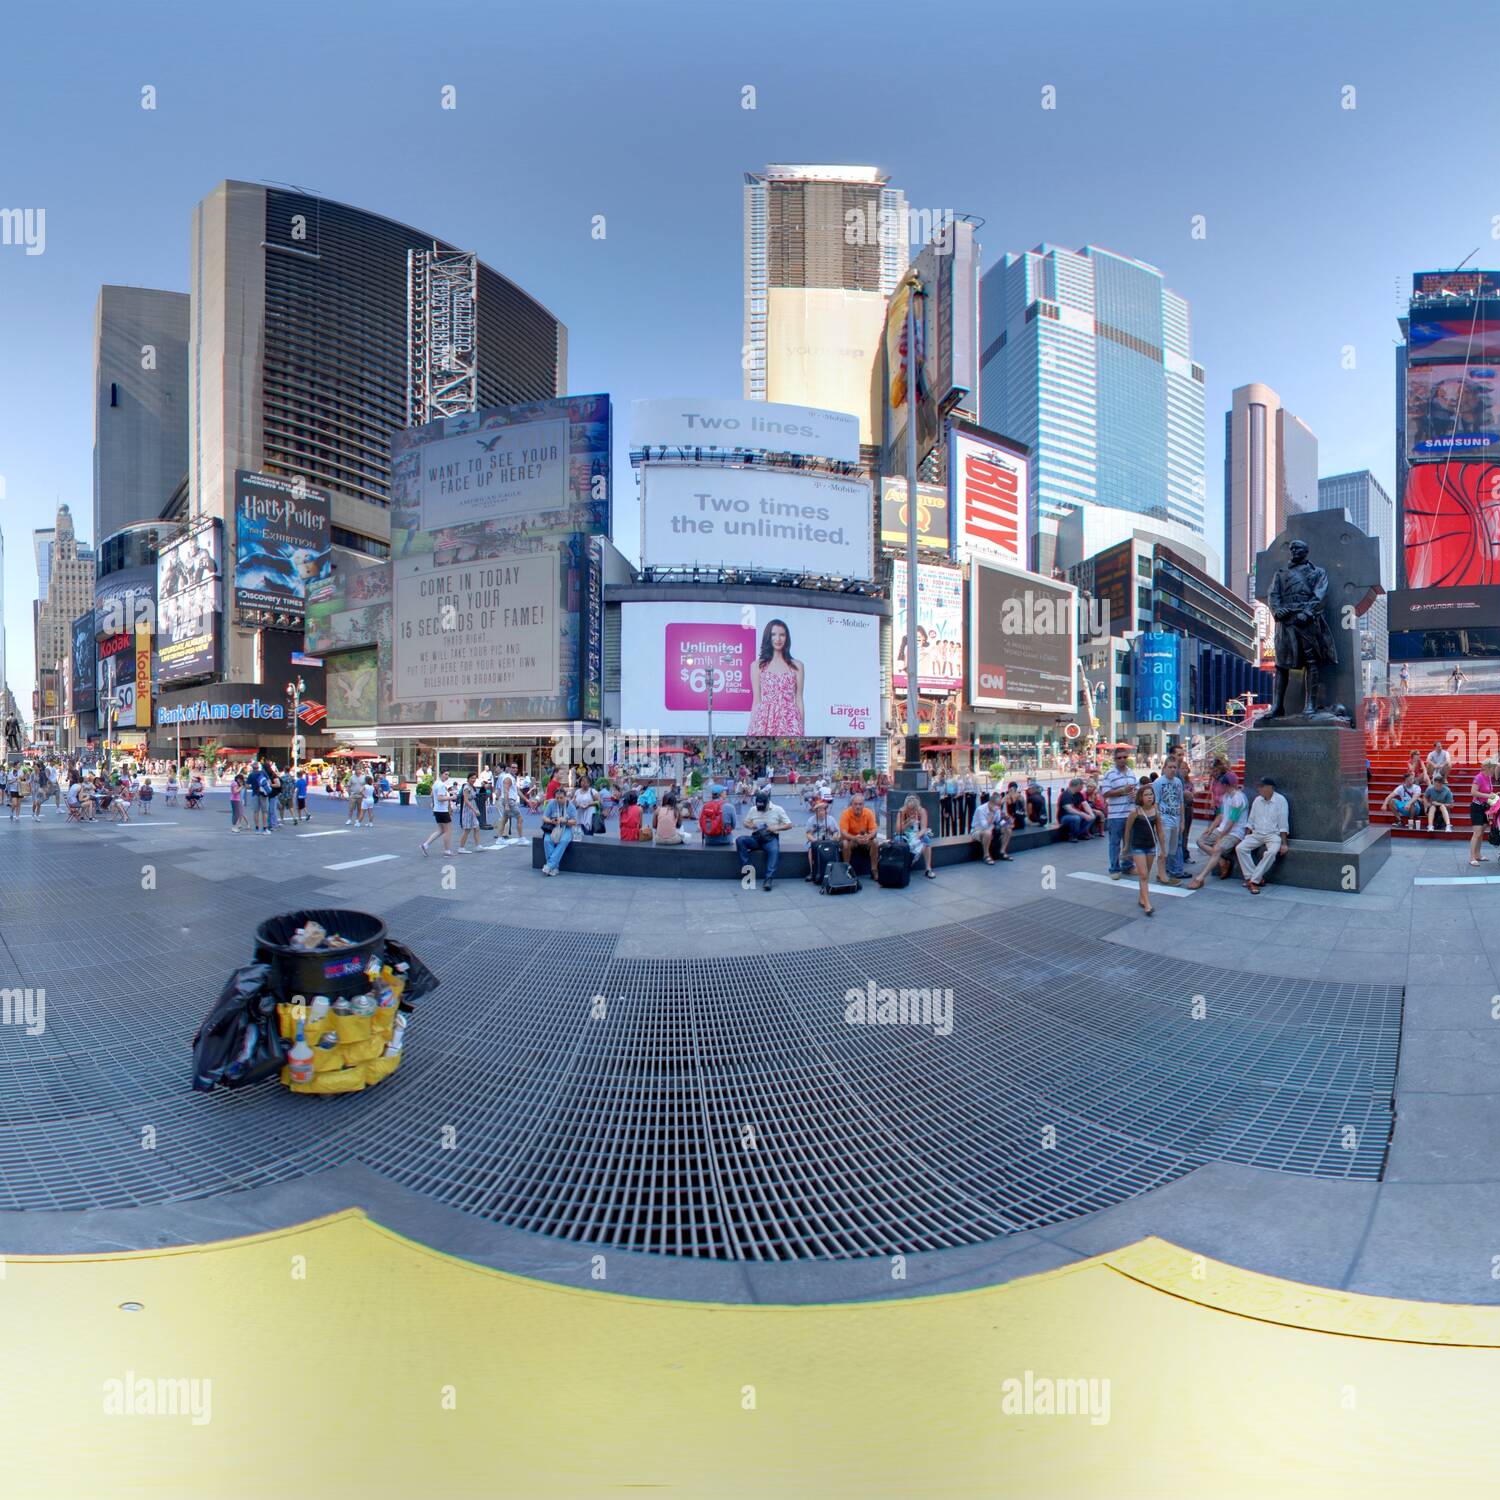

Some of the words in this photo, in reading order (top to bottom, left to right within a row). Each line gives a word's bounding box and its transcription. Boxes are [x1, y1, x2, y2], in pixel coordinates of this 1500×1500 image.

[682, 414, 740, 430] Two
[752, 416, 820, 438] lines.
[1425, 438, 1490, 448] SAMSUNG
[428, 462, 460, 482] WANT
[468, 460, 482, 475] TO
[490, 453, 513, 470] SEE
[522, 446, 558, 464] YOUR
[440, 476, 470, 496] FACE
[477, 471, 493, 487] UP
[500, 464, 543, 482] HERE?
[240, 496, 284, 522] Harry
[284, 500, 325, 530] Potter
[694, 493, 750, 512] Two
[758, 498, 830, 521] times
[966, 456, 1018, 554] BILLY
[671, 514, 714, 534] the
[724, 518, 850, 546] unlimited.
[420, 576, 453, 598] COME
[460, 572, 472, 588] IN
[479, 566, 520, 586] TODAY
[436, 594, 460, 614] FOR
[467, 589, 500, 610] YOUR
[400, 621, 412, 639] 15
[482, 610, 496, 630] OF
[504, 606, 544, 628] FAME!
[100, 634, 130, 658] Kodak
[450, 648, 466, 659] TAKE
[470, 646, 488, 658] YOUR
[680, 641, 742, 654] Unlimited
[137, 650, 150, 699] Kodak
[440, 662, 456, 674] HERE
[476, 660, 494, 671] YOUR
[520, 657, 536, 668] OWN
[980, 674, 1004, 690] CNN
[158, 706, 184, 723] Bank
[186, 703, 200, 722] of
[200, 699, 284, 722] America
[830, 706, 870, 718] Largest
[848, 716, 866, 730] 4G
